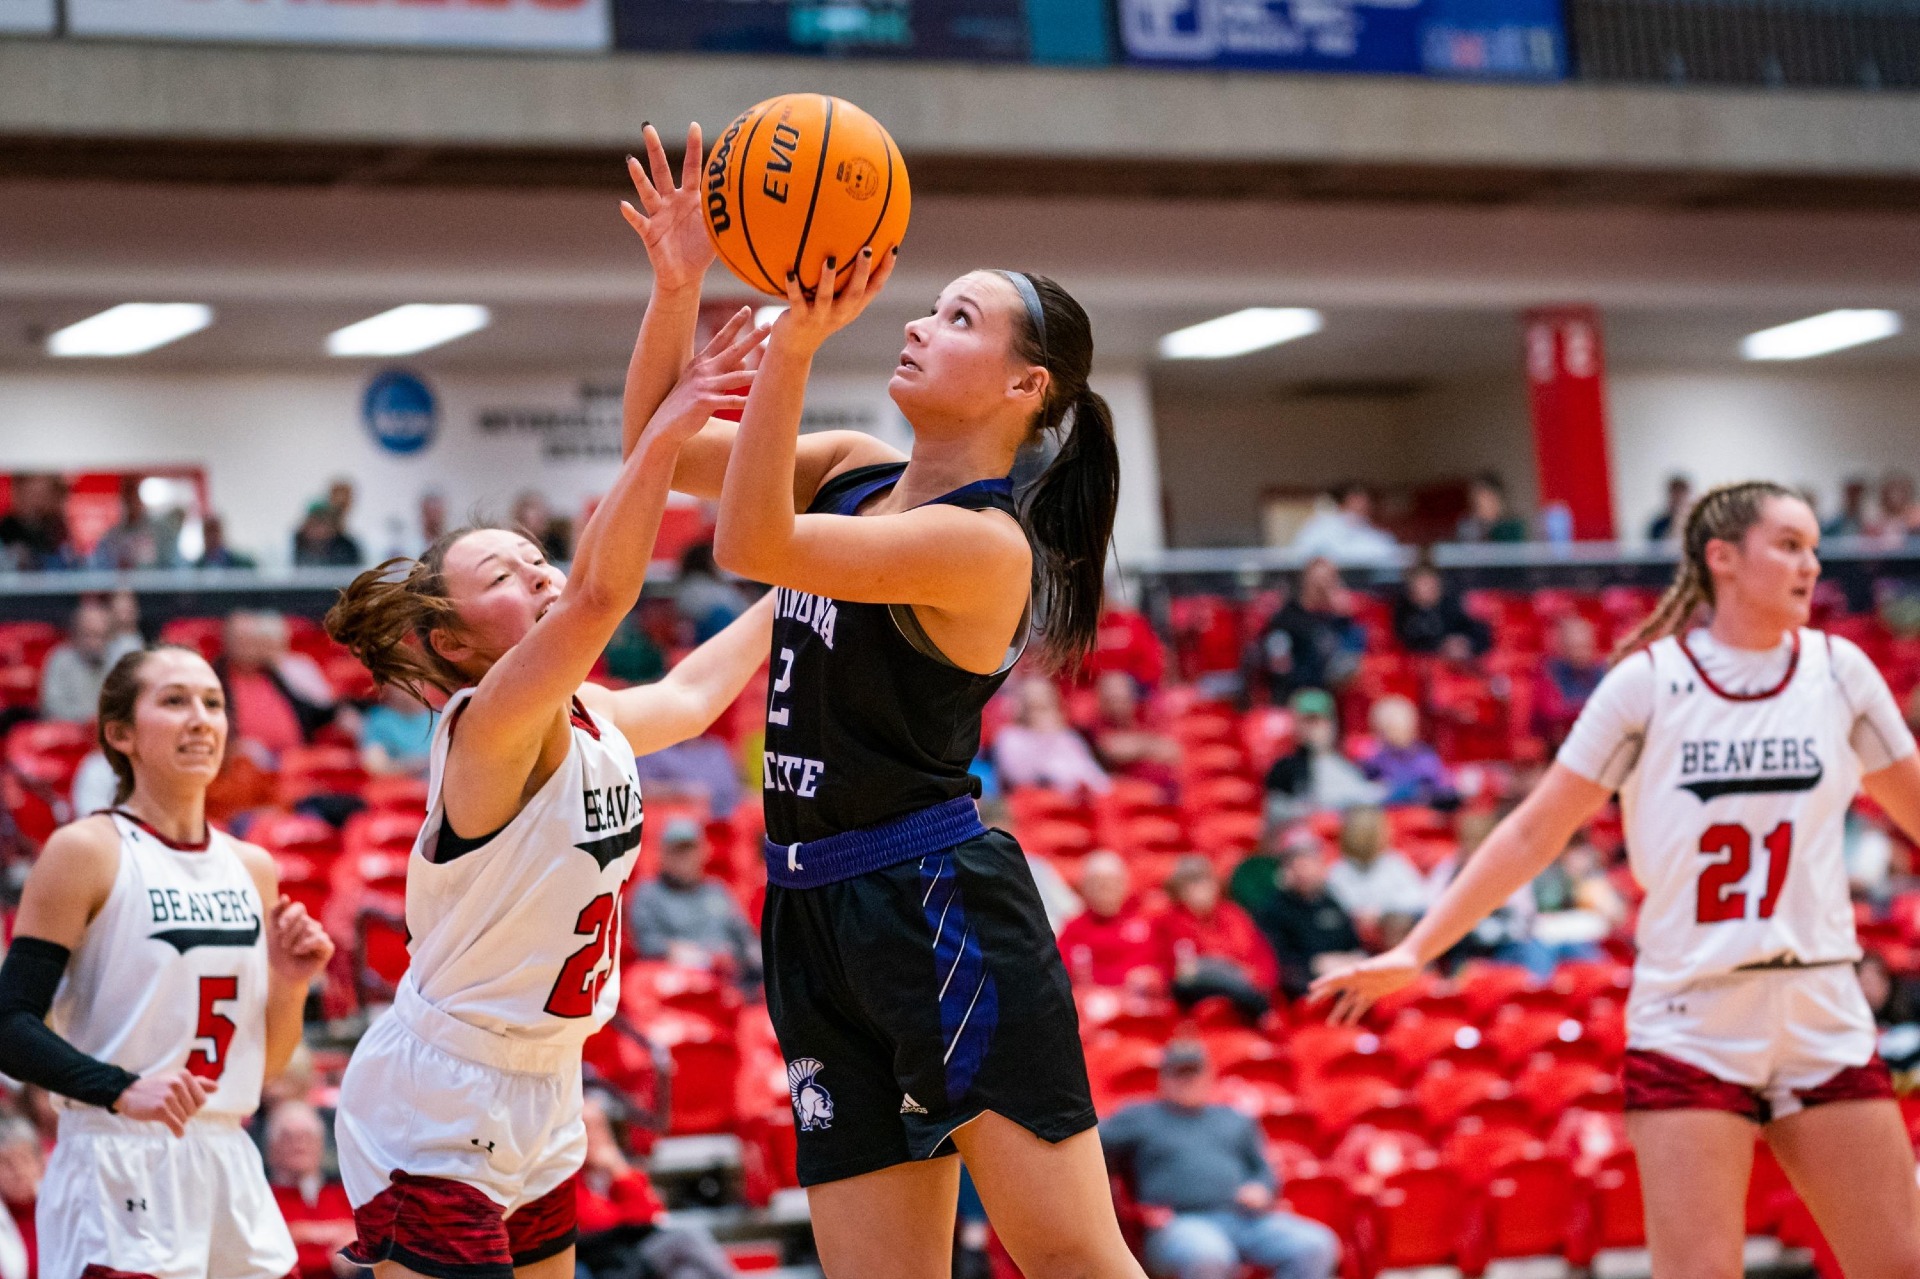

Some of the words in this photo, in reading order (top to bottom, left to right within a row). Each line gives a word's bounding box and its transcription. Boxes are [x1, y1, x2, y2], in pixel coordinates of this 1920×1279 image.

[763, 122, 800, 204] EVO
[768, 647, 795, 726] 2
[1682, 737, 1821, 775] BEAVERS
[583, 784, 643, 832] BEAV
[1696, 820, 1793, 923] 21
[543, 879, 626, 1018] 2
[186, 976, 238, 1081] 5
